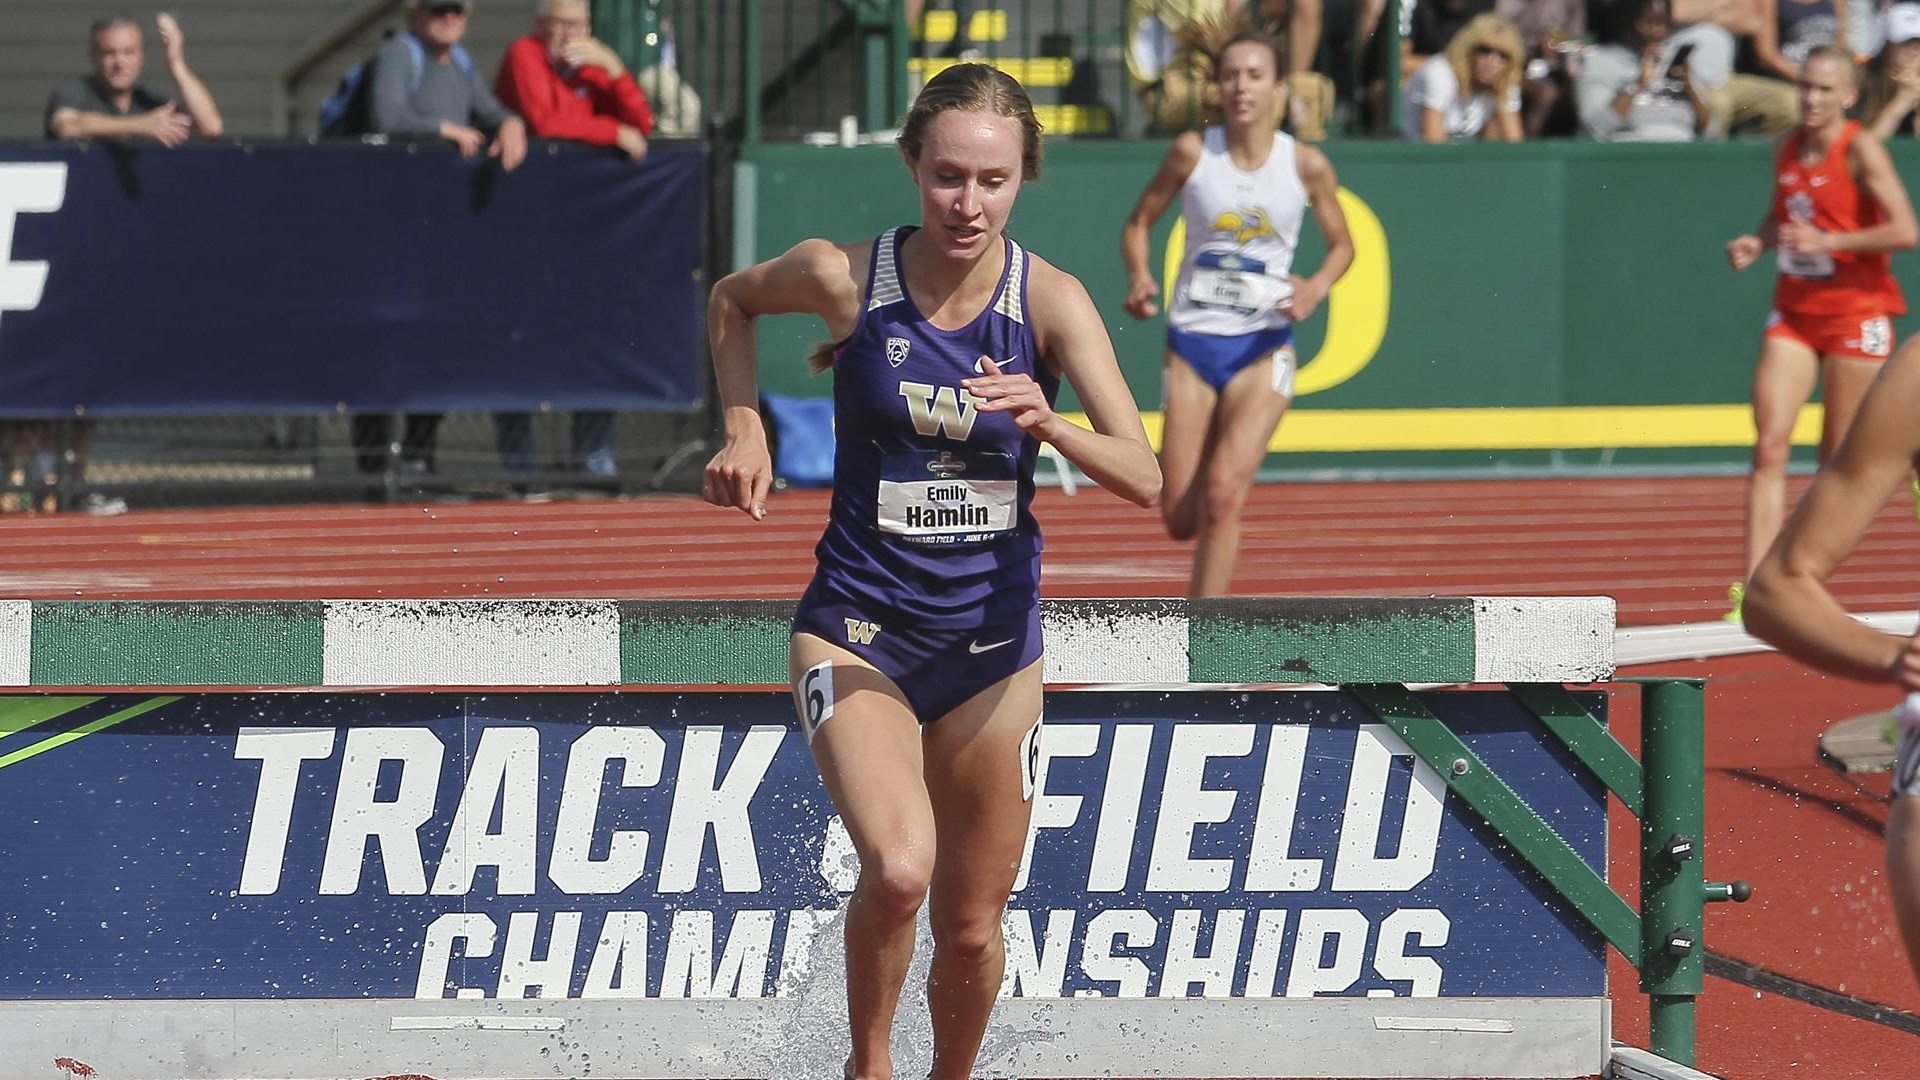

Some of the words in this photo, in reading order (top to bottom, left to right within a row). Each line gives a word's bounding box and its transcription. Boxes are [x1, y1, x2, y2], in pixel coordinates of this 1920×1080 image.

[887, 339, 909, 356] PAC
[890, 350, 903, 361] 12
[899, 381, 987, 441] W
[927, 485, 967, 501] Emily
[906, 504, 988, 528] Hamlin
[963, 534, 981, 542] JUNE
[844, 617, 881, 645] W
[805, 668, 824, 730] 6
[234, 725, 787, 895] TRACK
[1010, 723, 1448, 892] FIELD
[413, 908, 1450, 998] CHAMNSHIPS
